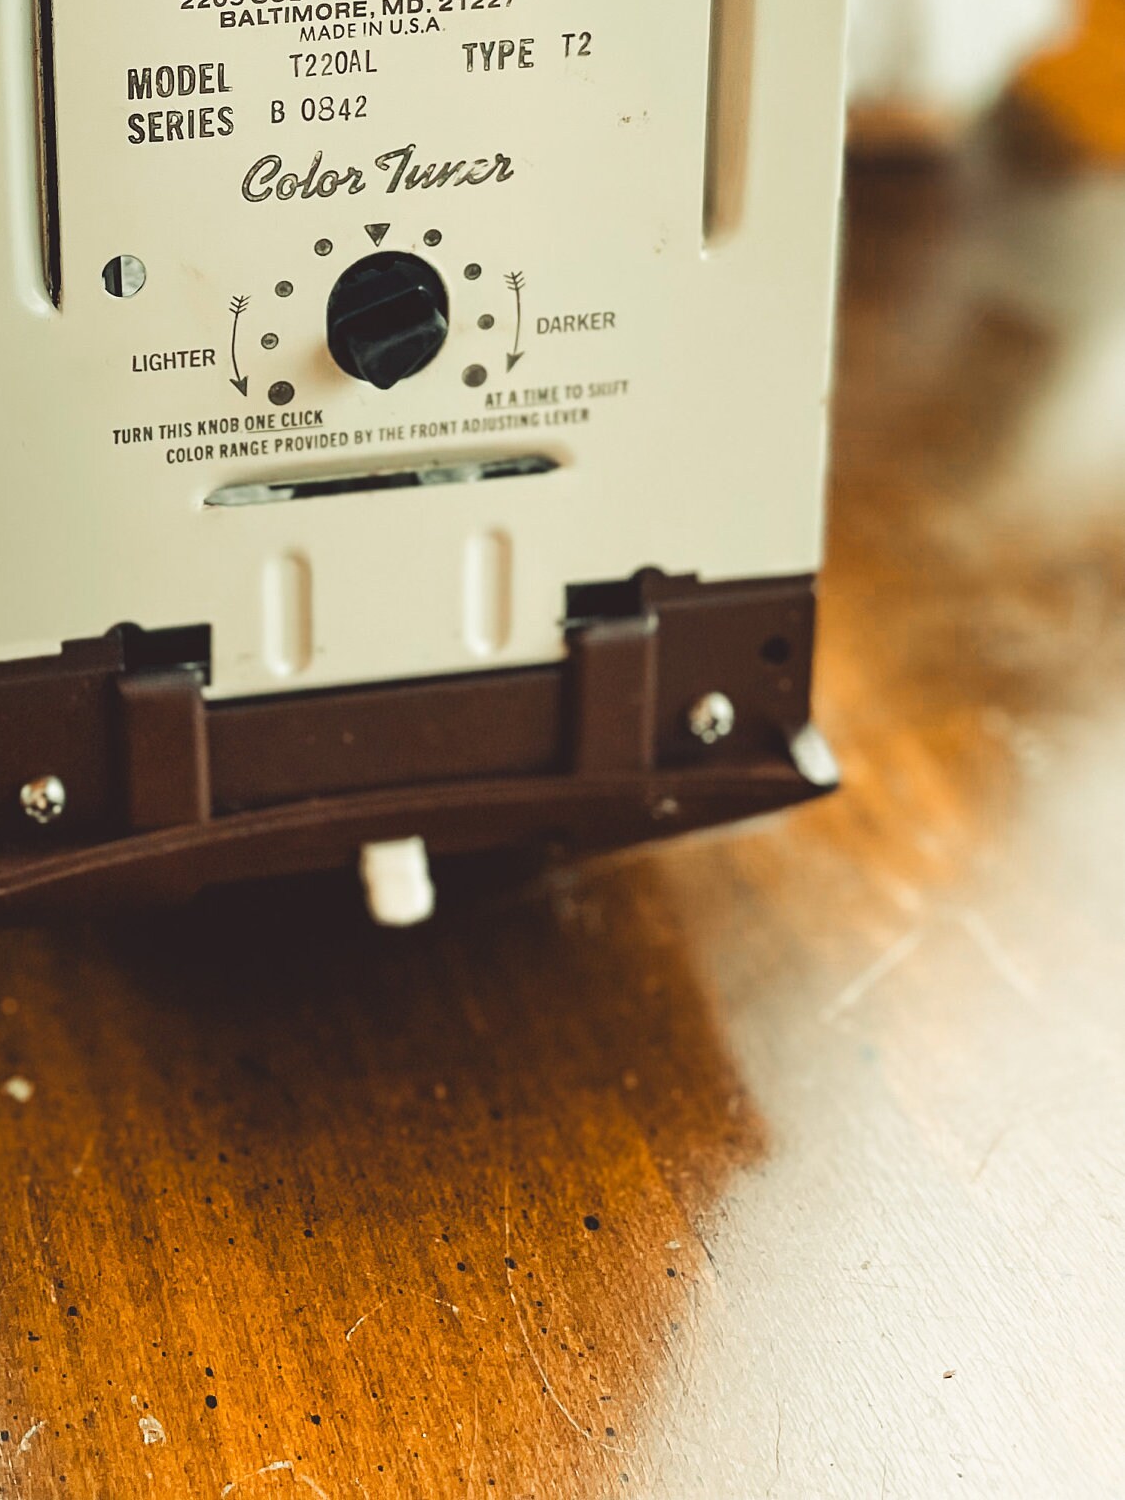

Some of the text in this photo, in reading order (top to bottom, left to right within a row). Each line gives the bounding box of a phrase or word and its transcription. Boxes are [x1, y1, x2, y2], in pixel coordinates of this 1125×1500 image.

[219, 0, 376, 29] BALTIMORE,
[299, 23, 356, 42] MADE
[363, 20, 382, 37] IN
[128, 32, 591, 100] MODEL T220AL TYPE T2
[128, 95, 366, 144] SERIES B 0842
[242, 143, 514, 202] Color Tuner
[537, 312, 615, 334] DARKER
[133, 349, 215, 372] LIGHTER
[484, 391, 503, 408] AT
[507, 388, 519, 405] A
[523, 385, 559, 404] TIME
[566, 385, 582, 398] TO
[113, 409, 324, 444] TURN THIS KNOB ONE CLICK
[166, 409, 588, 464] COLOR RANGE PROVIDED BY THE FRONT ADJUSTING LEVER
